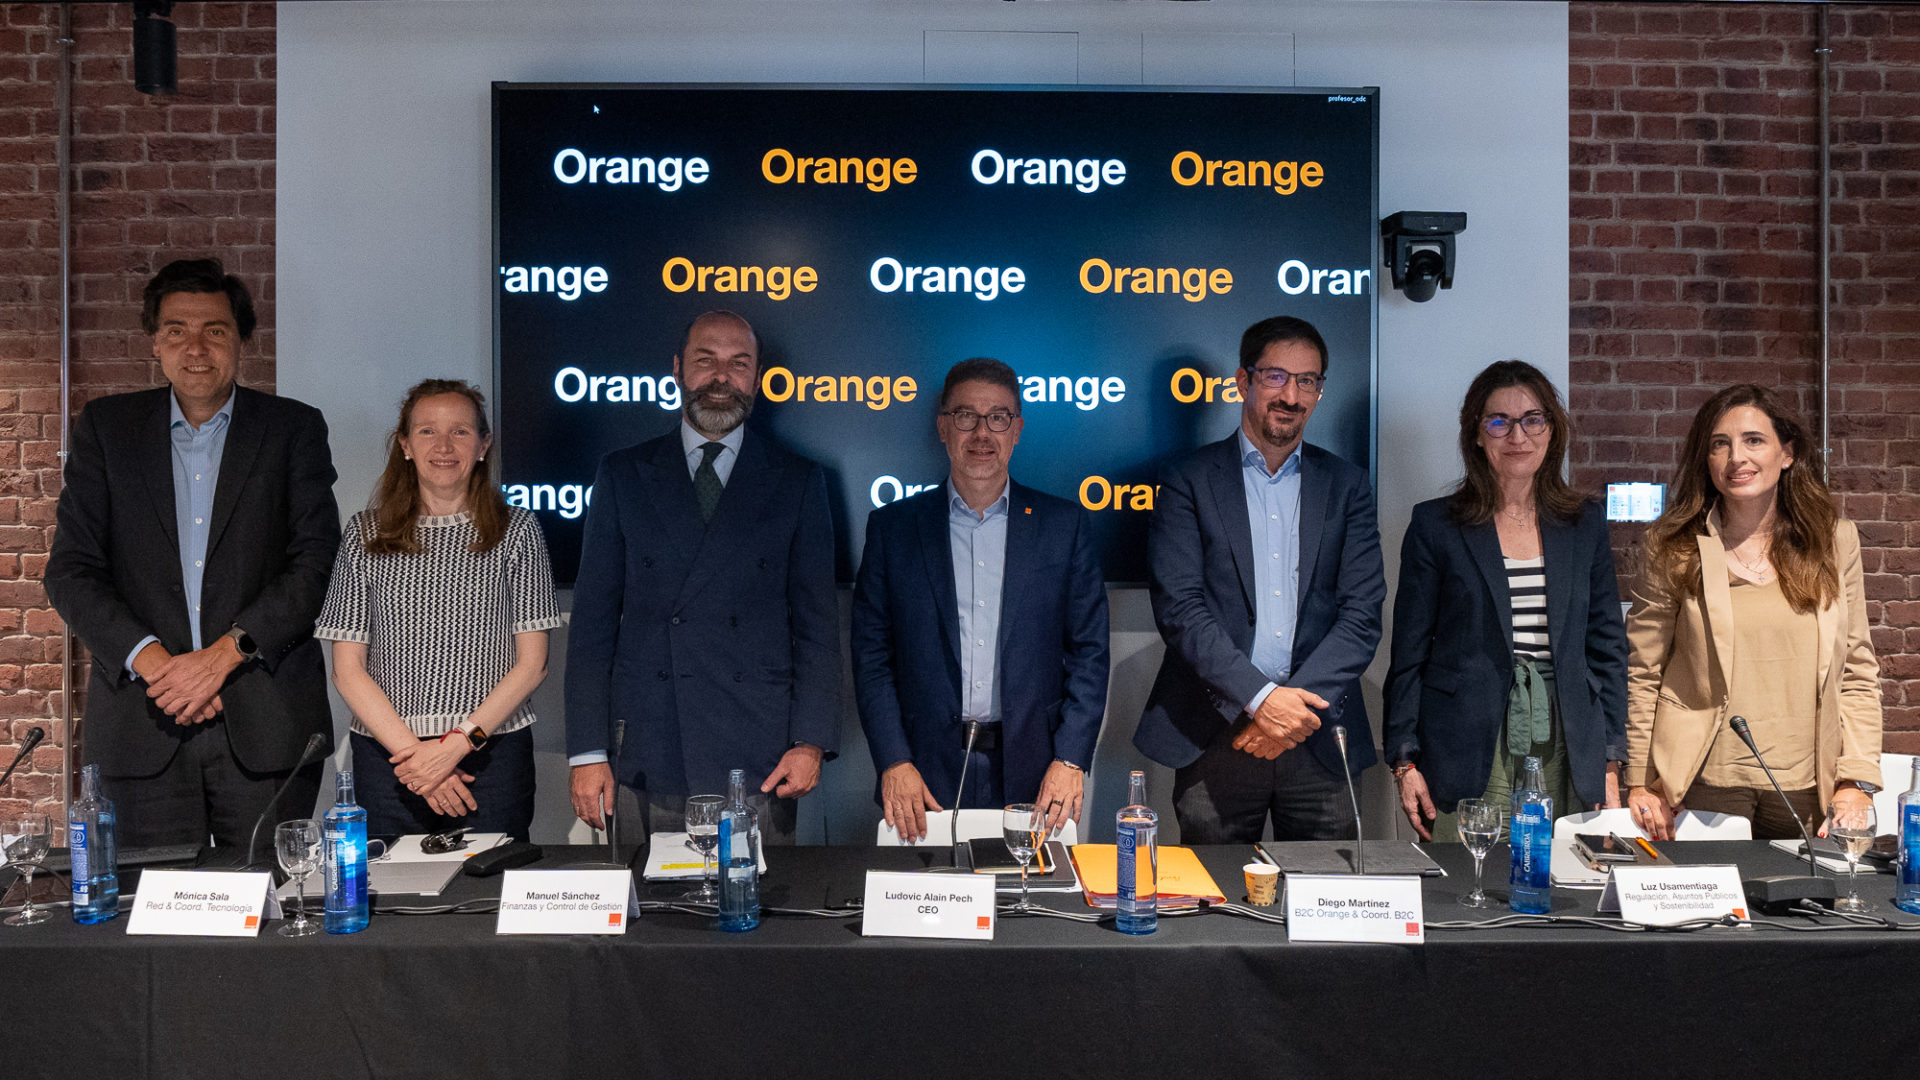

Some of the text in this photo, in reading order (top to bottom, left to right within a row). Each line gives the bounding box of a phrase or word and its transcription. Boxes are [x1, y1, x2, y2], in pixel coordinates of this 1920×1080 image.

[1327, 95, 1367, 104] profesor_odc
[553, 148, 710, 192] Orange
[761, 148, 918, 193] Orange
[971, 149, 1127, 194] Orange
[1170, 150, 1324, 196] Orange
[661, 256, 819, 301] Orange
[870, 256, 1026, 301] Orange
[1079, 257, 1234, 302] Orange
[554, 366, 682, 411] Orang
[761, 366, 918, 411] Orange
[1016, 375, 1126, 411] ange
[1170, 367, 1230, 403] Ora
[501, 484, 594, 519] ang
[1078, 475, 1161, 511] Ora
[174, 891, 230, 901] Mónica Sala
[526, 892, 600, 900] Manuel Sánchez
[885, 891, 973, 903] Ludovic Alain Pech
[1318, 898, 1346, 908] Diego
[1641, 882, 1718, 891] Luz Usamentiaga
[146, 901, 164, 910] Red
[166, 902, 172, 910] &
[174, 902, 204, 911] Coord.
[501, 902, 537, 911] Finanzas
[539, 904, 544, 912] y
[546, 903, 576, 911] Control
[578, 903, 589, 911] de
[917, 906, 939, 914] CEO
[1295, 909, 1414, 920] B2C Orange & Coord. B2C
[1653, 903, 1658, 911] y
